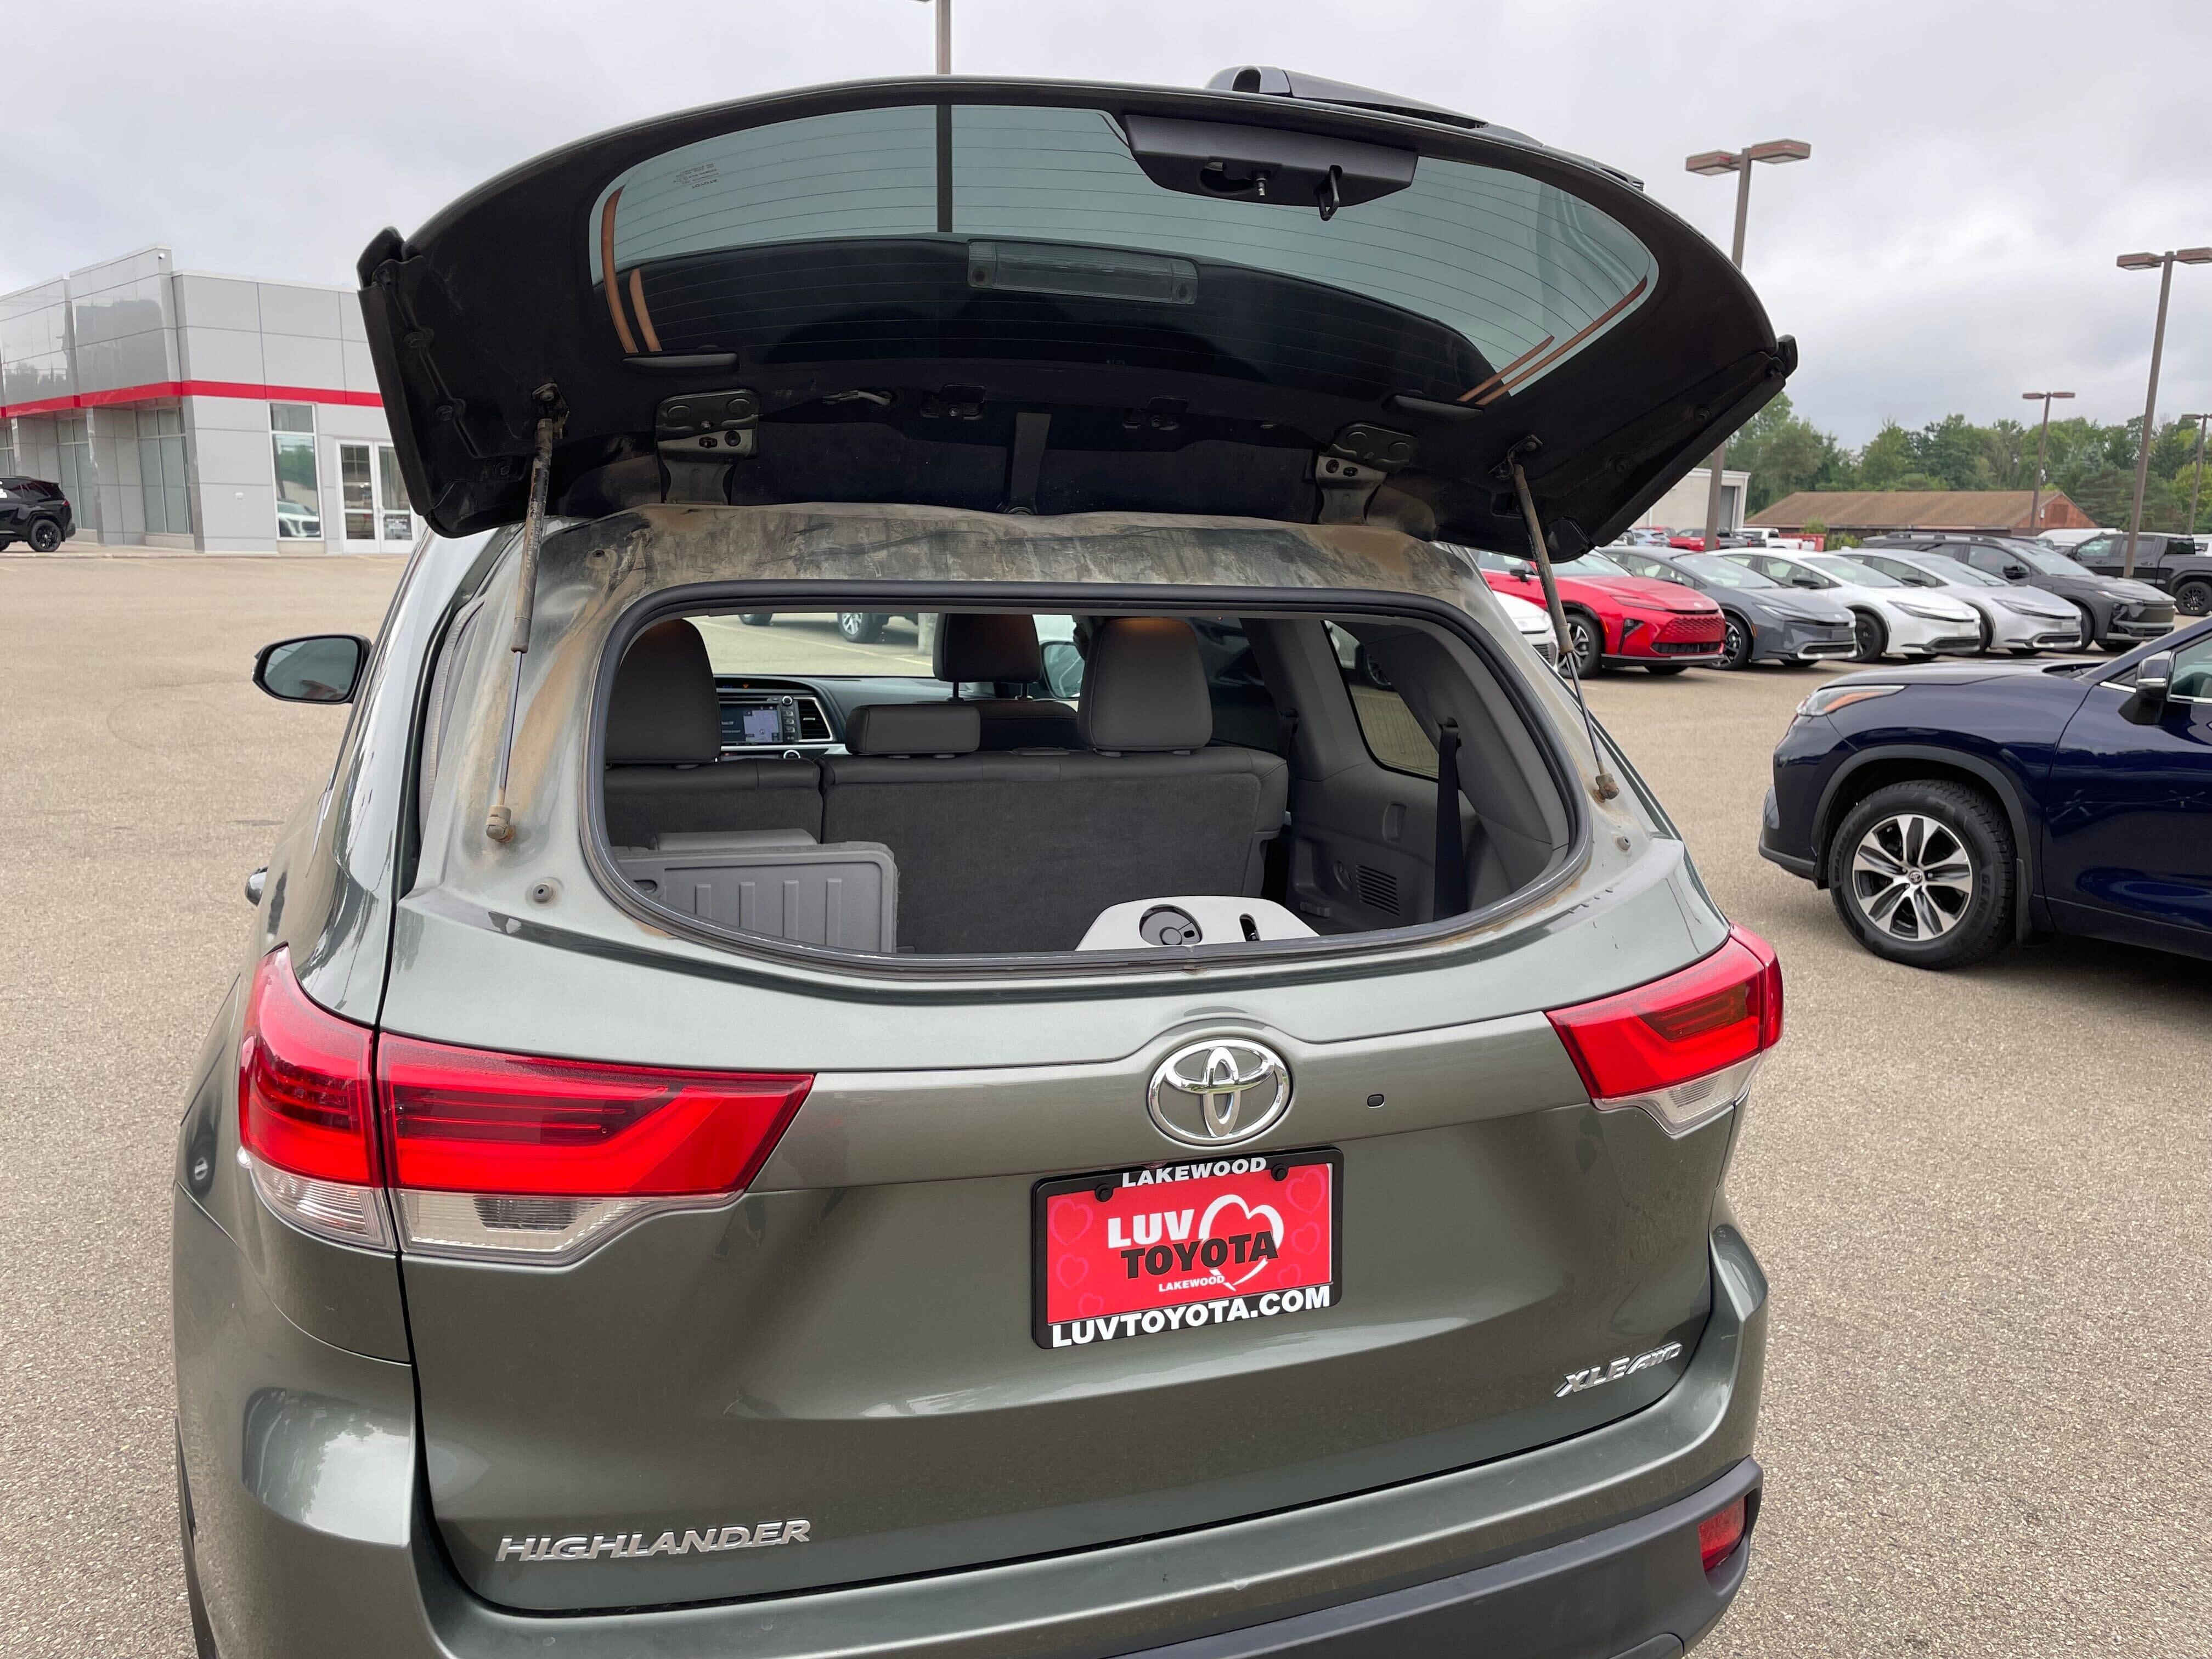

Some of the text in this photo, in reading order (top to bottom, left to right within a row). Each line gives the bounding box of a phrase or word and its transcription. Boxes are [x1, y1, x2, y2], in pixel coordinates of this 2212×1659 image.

[1122, 1157, 1267, 1188] LAKEWOOD
[1108, 1208, 1195, 1249] LUV
[1120, 1231, 1279, 1279] TOYOTA
[1158, 1274, 1226, 1293] LAKEWOOD
[1051, 1285, 1331, 1348] LUVTOYOTA.COM
[1555, 1356, 1630, 1398] XLE
[495, 1519, 811, 1561] HIGHLANDER
